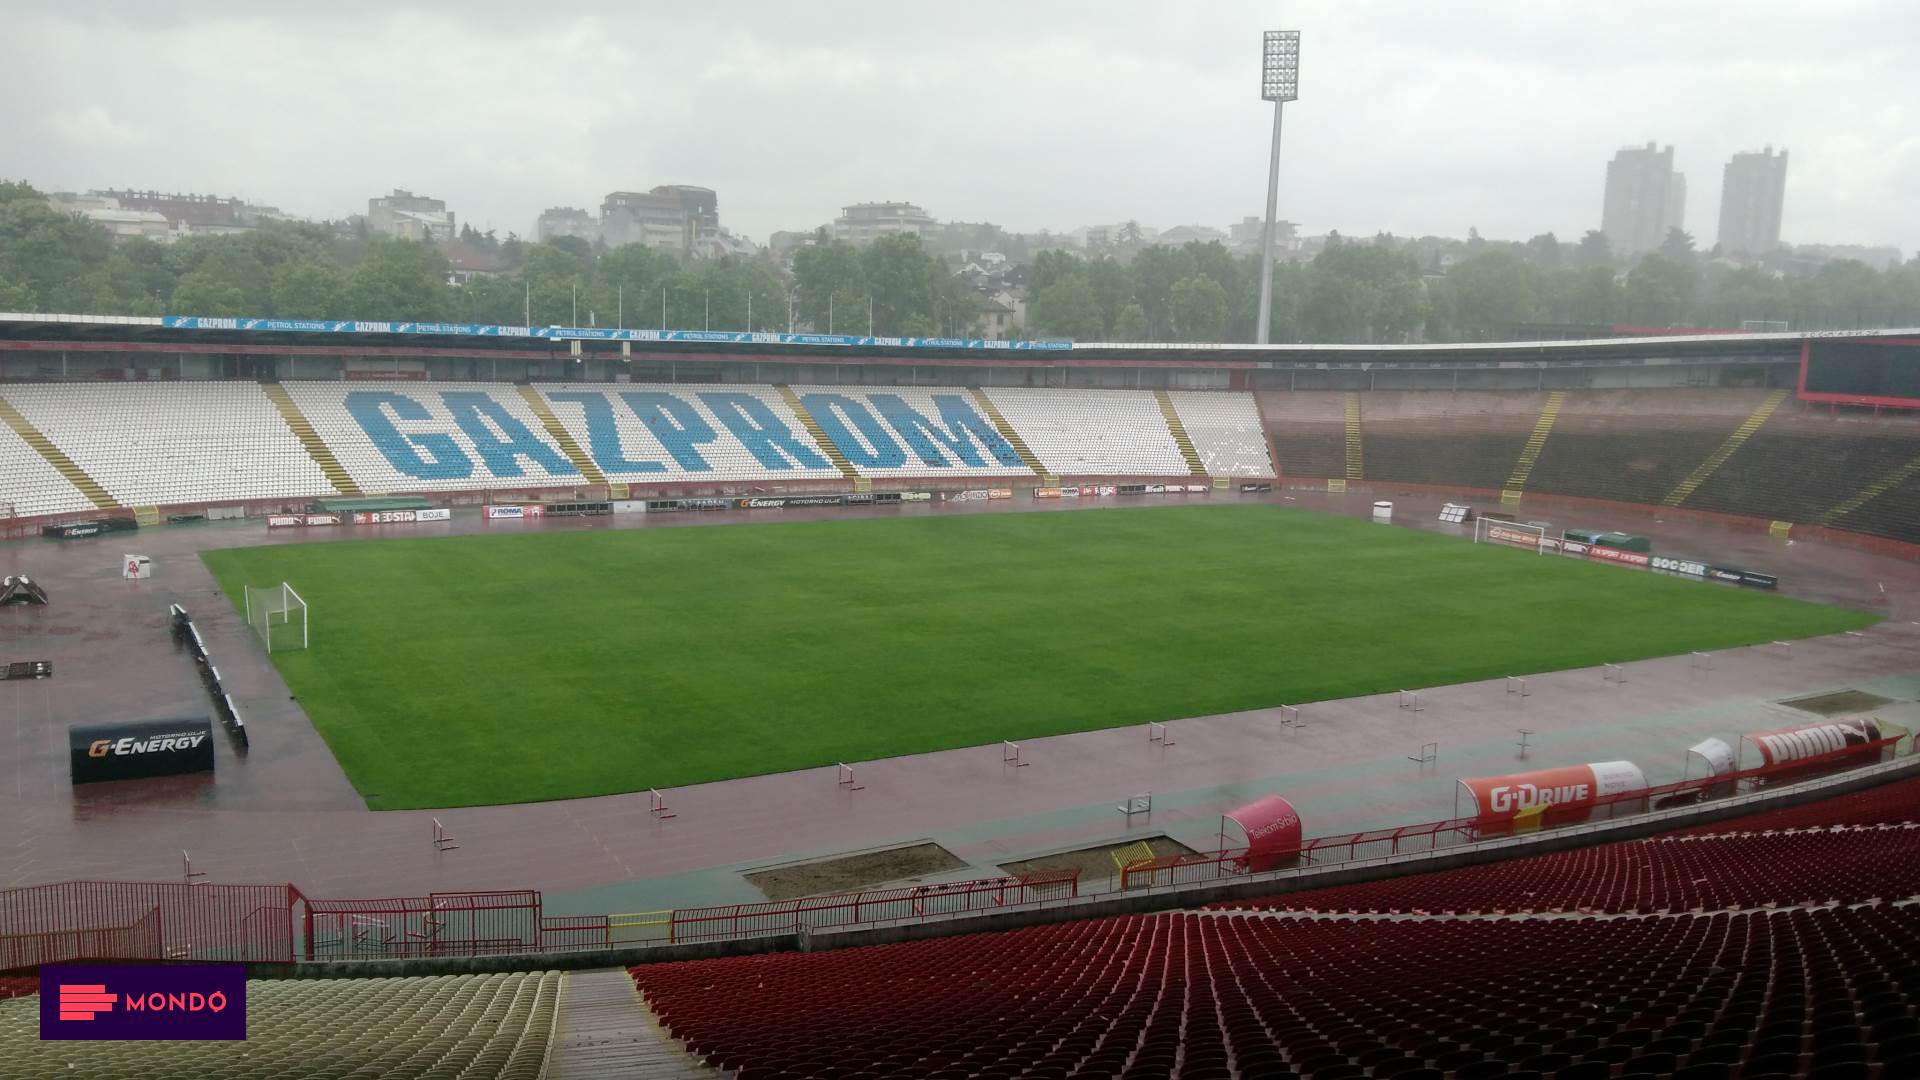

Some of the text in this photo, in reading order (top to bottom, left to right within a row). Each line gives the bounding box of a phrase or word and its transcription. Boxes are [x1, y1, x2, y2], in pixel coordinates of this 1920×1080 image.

[197, 317, 237, 329] GAZPROM
[267, 320, 325, 330] PETROL STATIONS
[355, 321, 391, 332] GAZPROM
[418, 324, 441, 332] PETROL
[498, 326, 530, 337] GAZPROM
[630, 330, 660, 340] GAZPROM
[752, 332, 781, 342] GAZPROM
[875, 336, 901, 346] GAZPROM
[345, 391, 1027, 479] GAZPROM
[423, 511, 444, 519] BOJE
[270, 517, 294, 526] PUMA
[308, 516, 332, 525] PUMA
[150, 732, 187, 740] MOTORNO
[88, 735, 204, 758] G-ENERGY
[1490, 783, 1589, 813] G-DRIVE
[1250, 814, 1298, 839] Telekom Srbija
